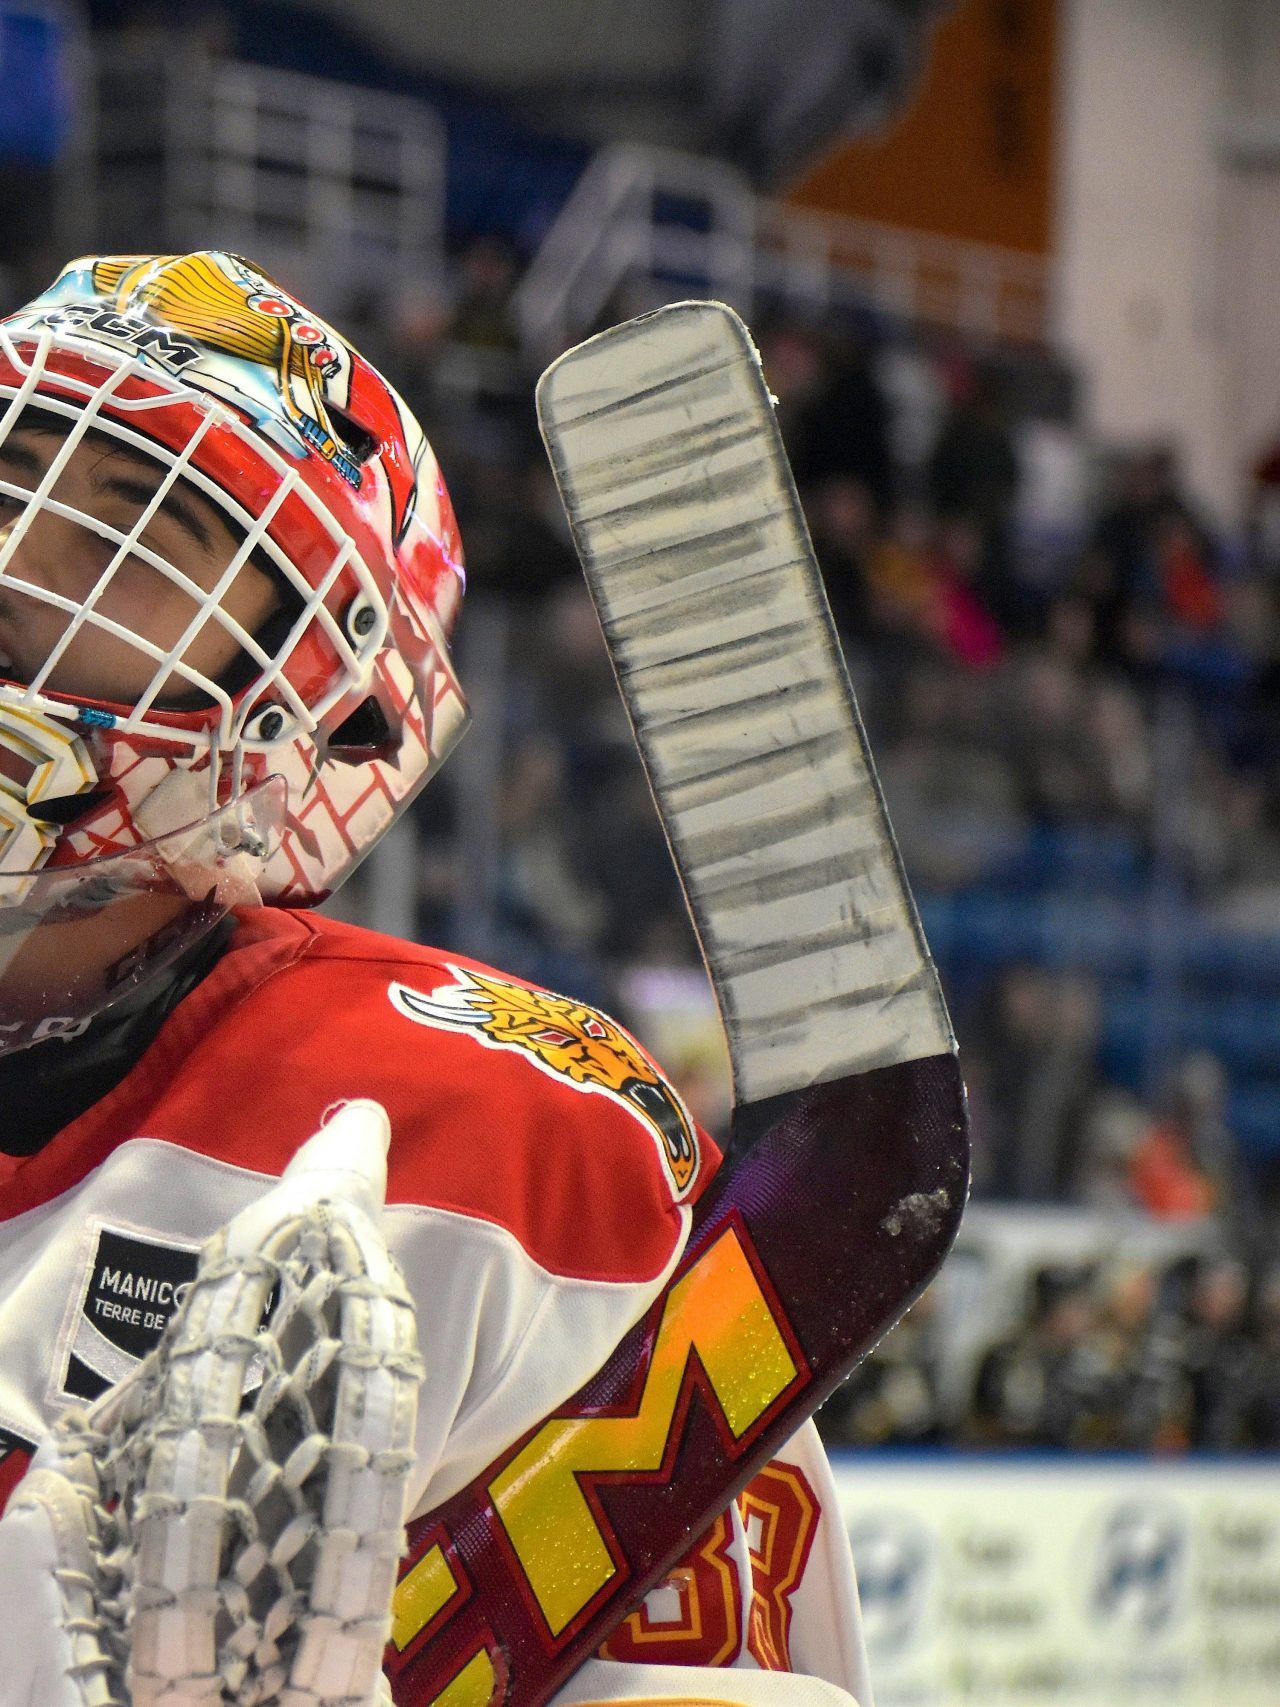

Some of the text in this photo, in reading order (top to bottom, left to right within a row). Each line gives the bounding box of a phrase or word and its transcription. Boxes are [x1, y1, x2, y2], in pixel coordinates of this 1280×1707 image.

[44, 303, 206, 370] CCM
[94, 1297, 166, 1331] TERRE DE
